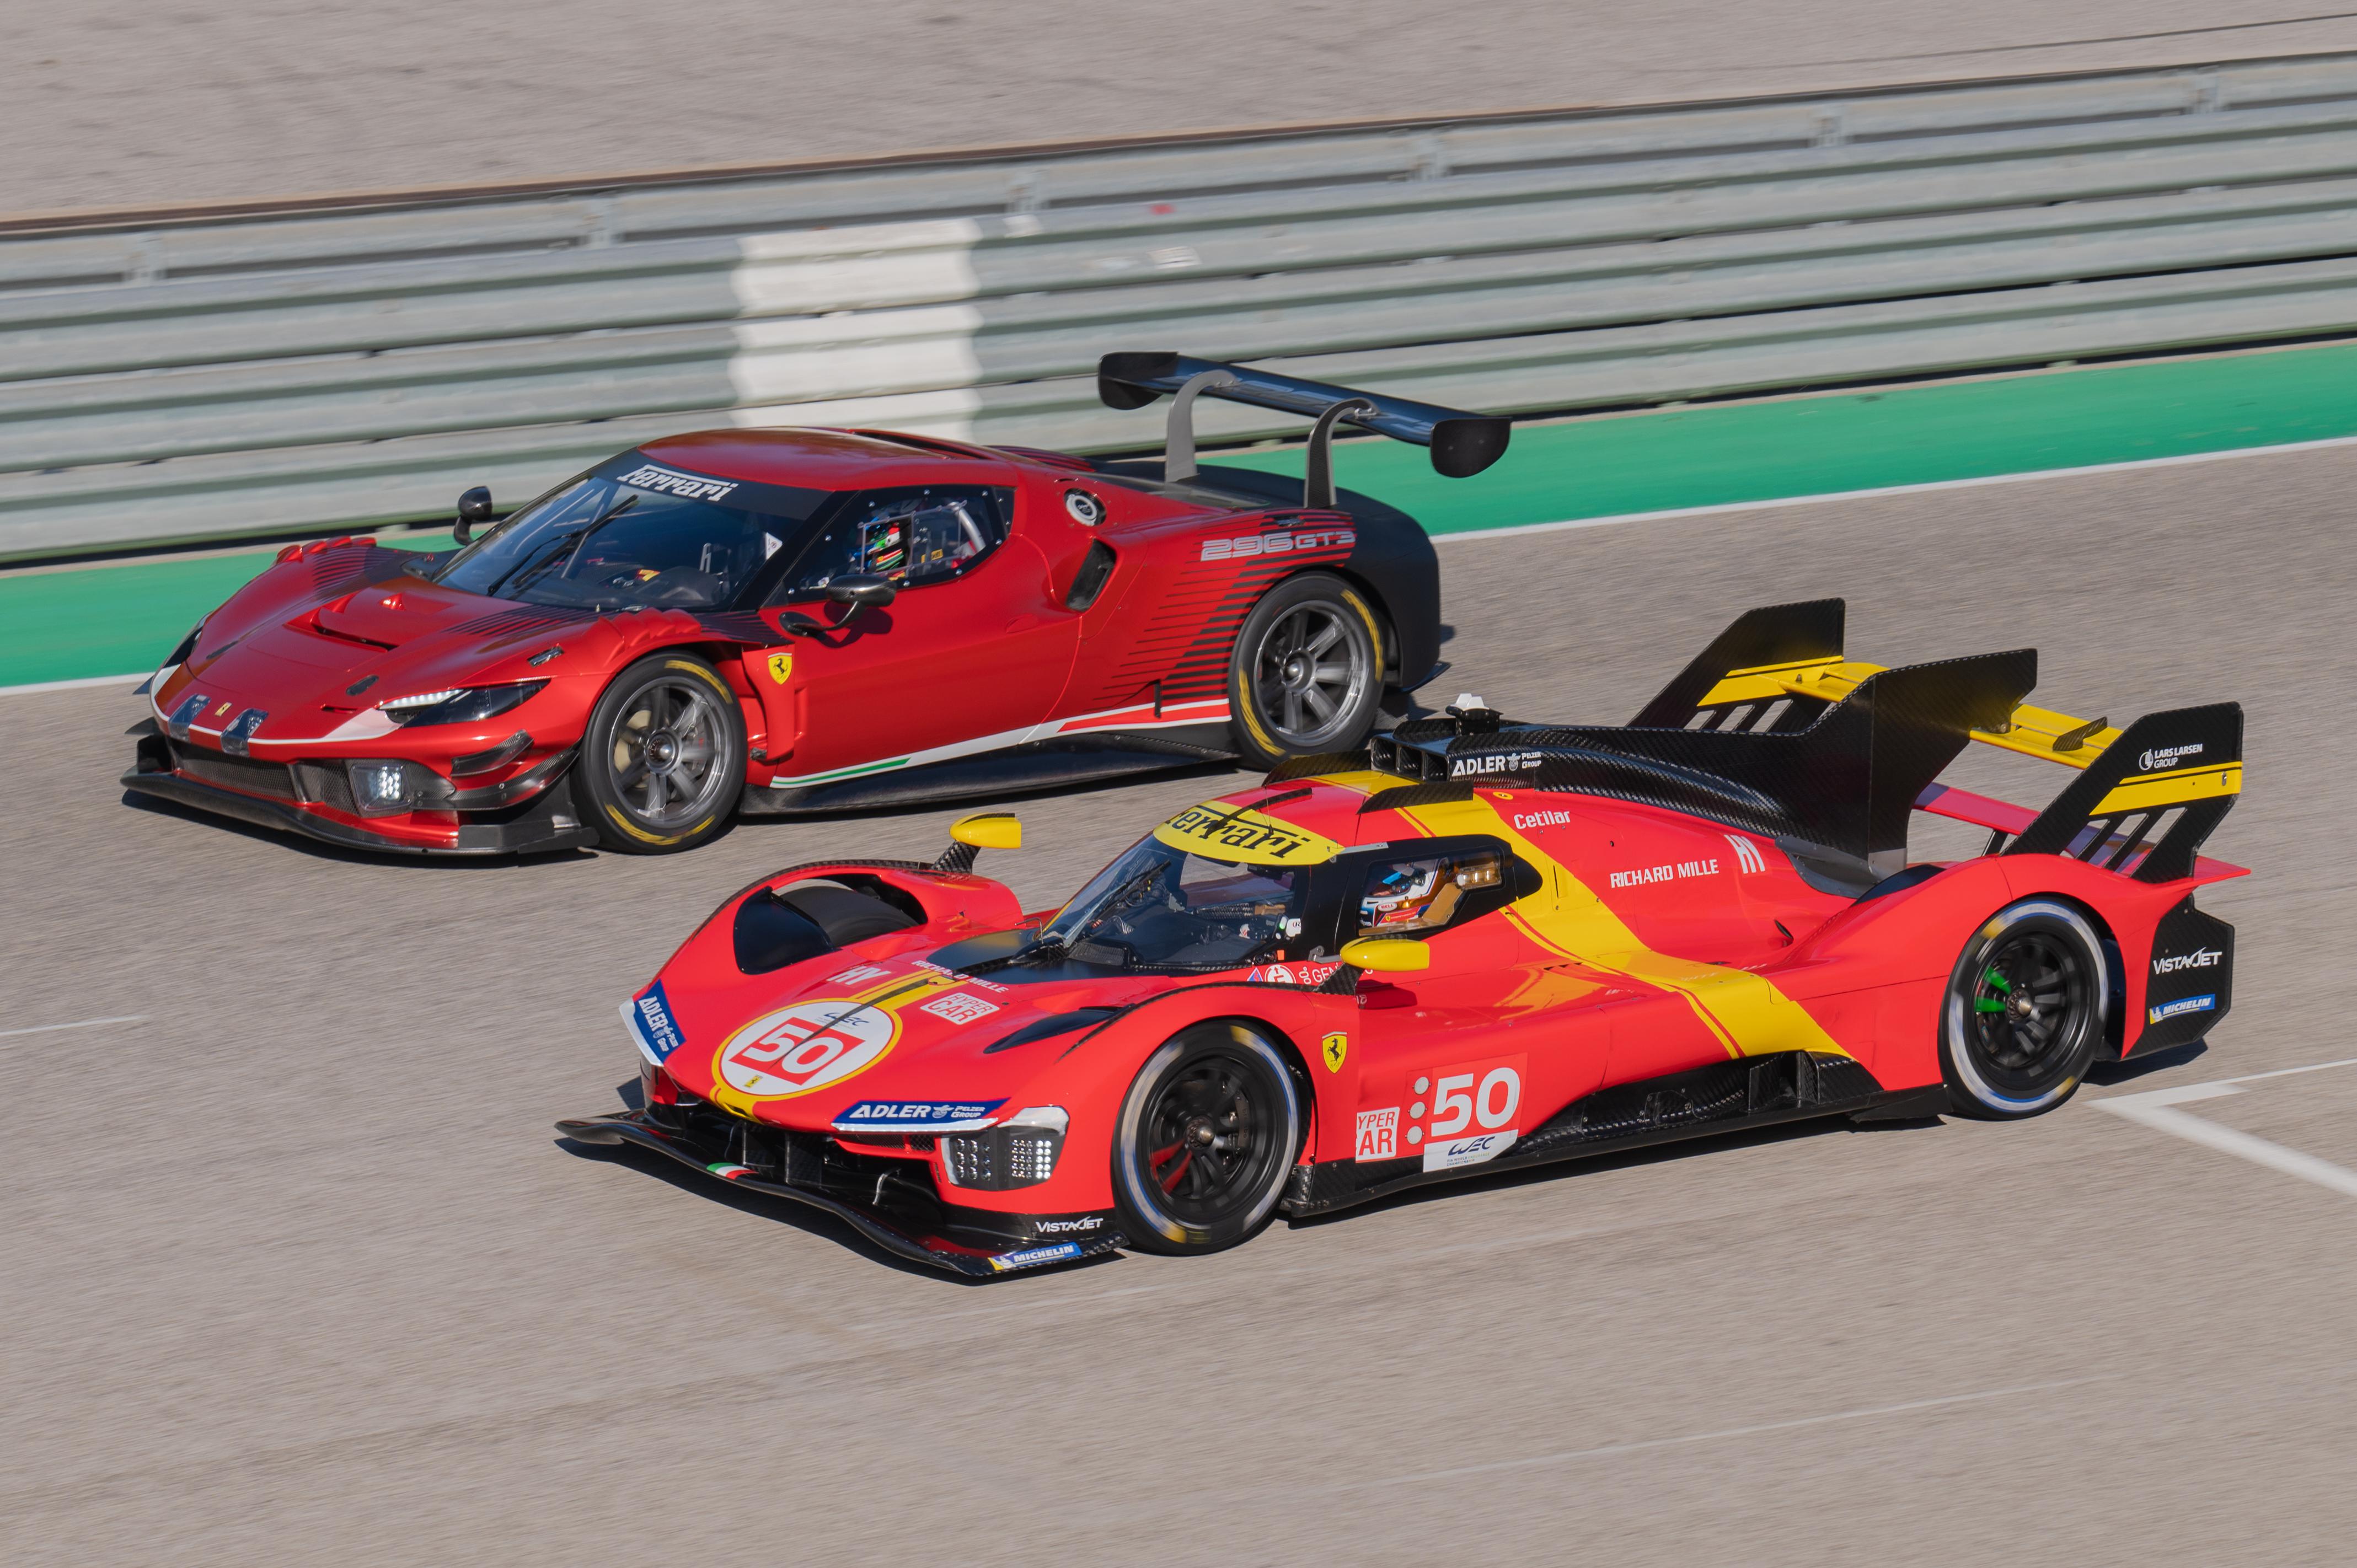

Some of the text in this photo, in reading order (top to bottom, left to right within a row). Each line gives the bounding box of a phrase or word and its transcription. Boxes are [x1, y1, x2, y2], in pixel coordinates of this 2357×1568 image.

[616, 464, 739, 502] Ferrari
[1201, 531, 1356, 561] 296 GT3
[2154, 743, 2203, 759] LARS LARSEN
[1451, 755, 1506, 777] ADLER
[1522, 760, 1541, 769] GROUP
[2154, 757, 2178, 769] GROUP
[1514, 810, 1571, 829] Cetilar
[1610, 859, 1719, 888] RICHARD MILLE
[2153, 947, 2222, 974] VISTAJET
[911, 960, 1009, 993] RICHAD MILLE
[639, 996, 668, 1032] ADLER
[928, 1001, 975, 1022] CAR
[947, 995, 993, 1013] HYPER
[2163, 997, 2211, 1015] MICHELIN
[742, 1024, 844, 1073] 50
[849, 1105, 931, 1118] ADLER
[1431, 1067, 1520, 1137] 50
[1358, 1111, 1395, 1130] YPER
[1358, 1128, 1393, 1156] AR
[1448, 1136, 1496, 1156] WEC
[1036, 1216, 1103, 1233] VISTAJET
[1014, 1245, 1074, 1263] MICHELIN
